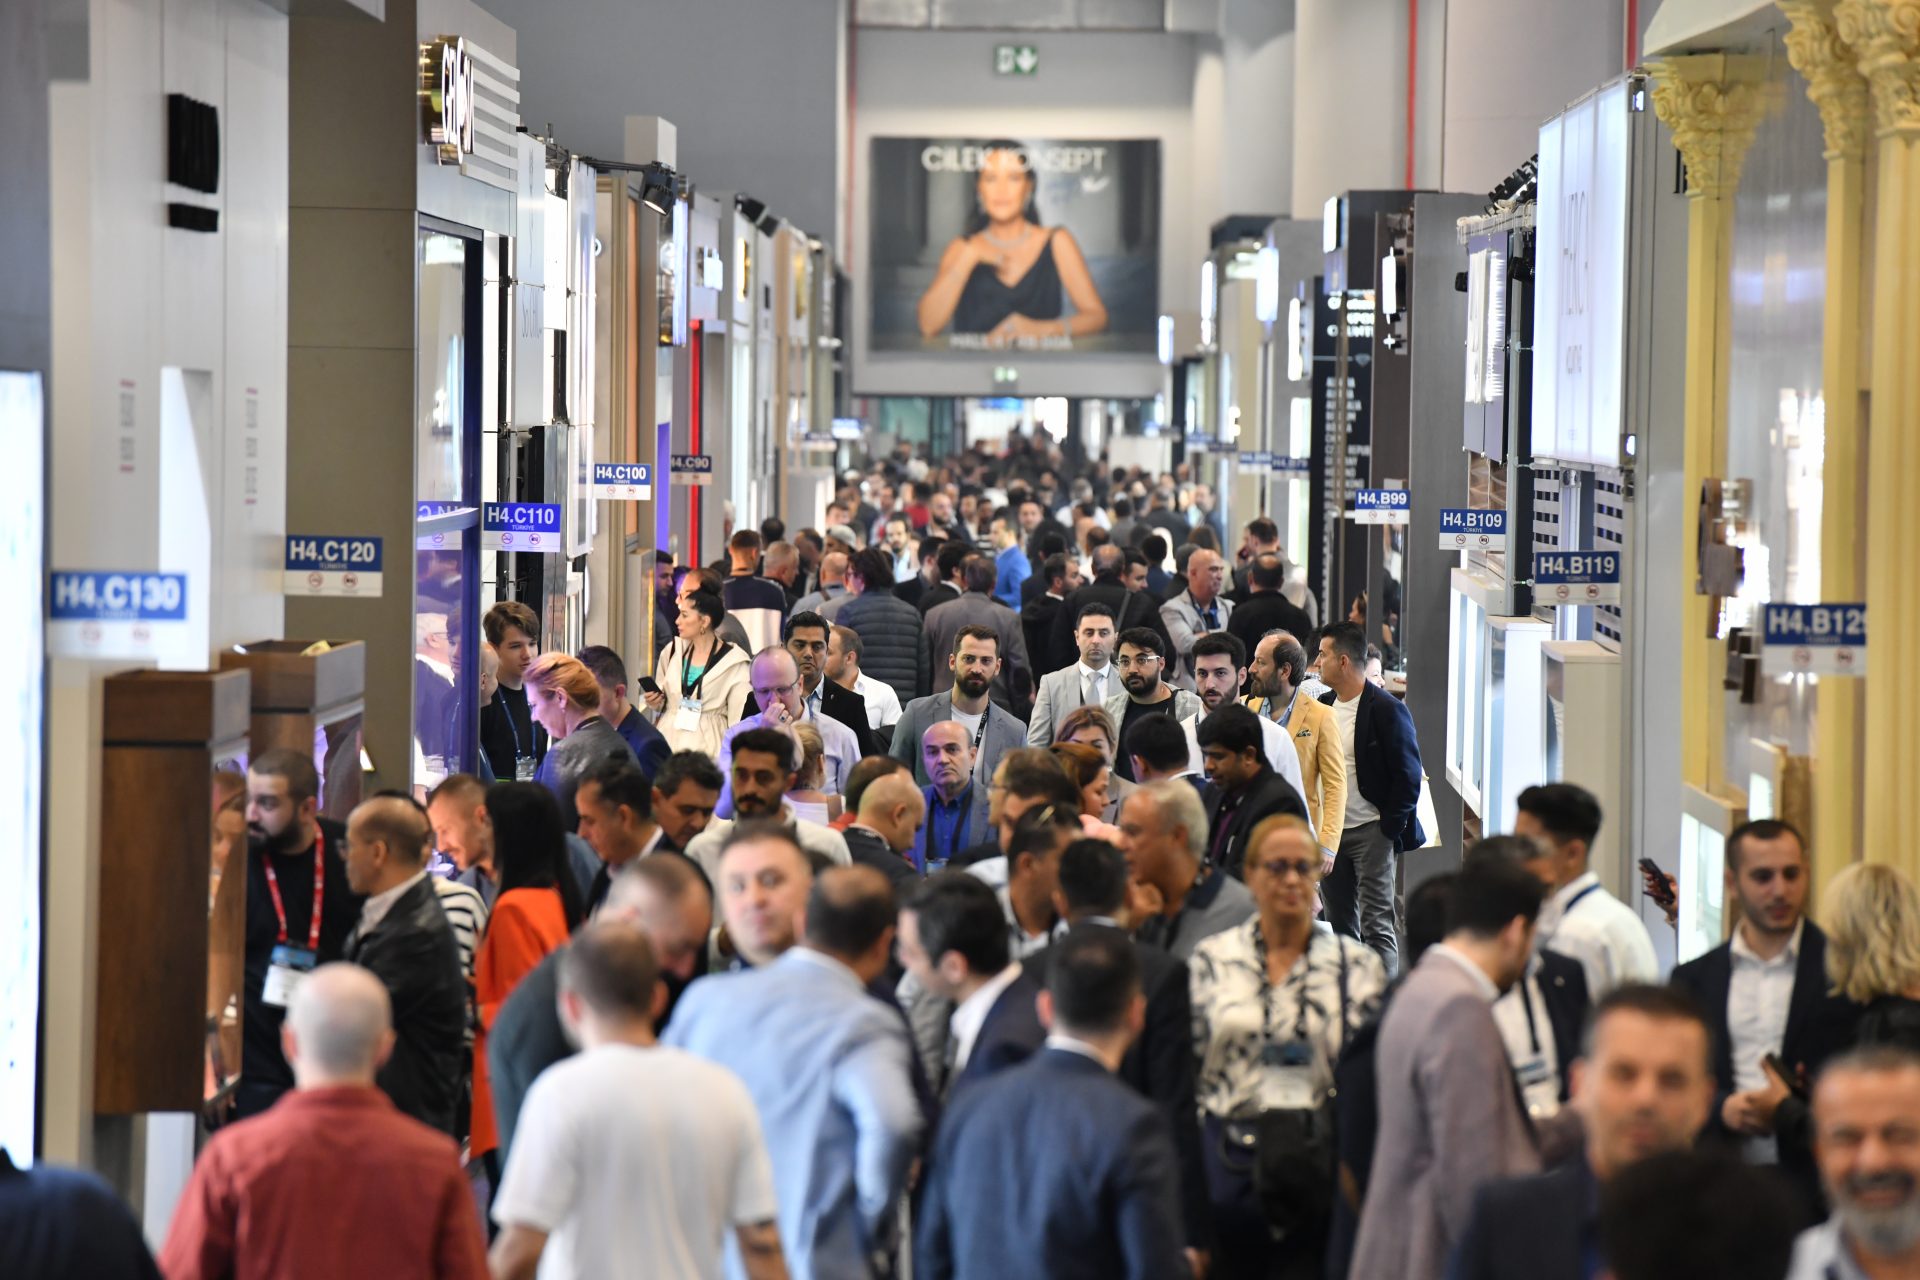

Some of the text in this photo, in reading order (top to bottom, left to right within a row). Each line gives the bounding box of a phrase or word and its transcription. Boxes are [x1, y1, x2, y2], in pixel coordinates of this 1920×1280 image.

[596, 465, 647, 480] H4.C100
[1358, 491, 1407, 505] H4.B99
[487, 506, 555, 525] H4.C110
[1443, 512, 1503, 528] H4.B109
[290, 540, 376, 563] H4.C120
[1540, 556, 1616, 575] H4.B119
[55, 574, 181, 612] H4.C130
